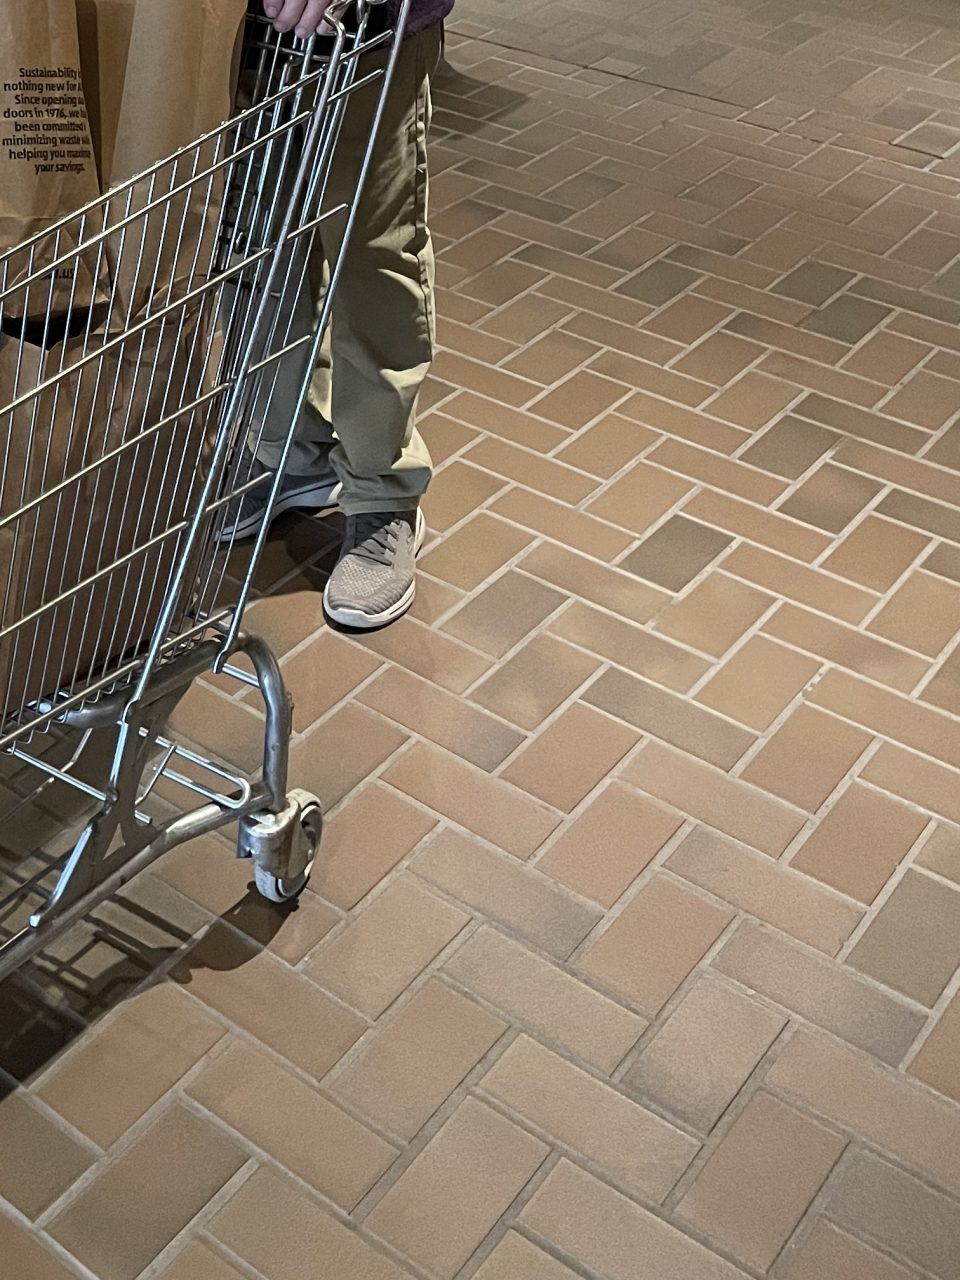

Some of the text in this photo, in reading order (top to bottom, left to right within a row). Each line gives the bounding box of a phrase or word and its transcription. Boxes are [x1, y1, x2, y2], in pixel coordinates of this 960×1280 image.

[19, 67, 78, 81] Sustainability
[3, 80, 44, 93] nothing
[45, 83, 65, 92] new
[66, 80, 77, 92] for
[14, 93, 40, 105] Since
[41, 94, 77, 107] opening
[3, 107, 34, 119] doors
[34, 107, 44, 118] in
[44, 108, 67, 119] 1976,
[68, 109, 80, 118] we
[14, 121, 41, 132] been
[42, 121, 84, 132] committed
[2, 134, 57, 147] minimizing
[58, 136, 81, 144] waste
[9, 148, 49, 161] helping
[50, 150, 66, 160] you
[34, 162, 54, 175] your
